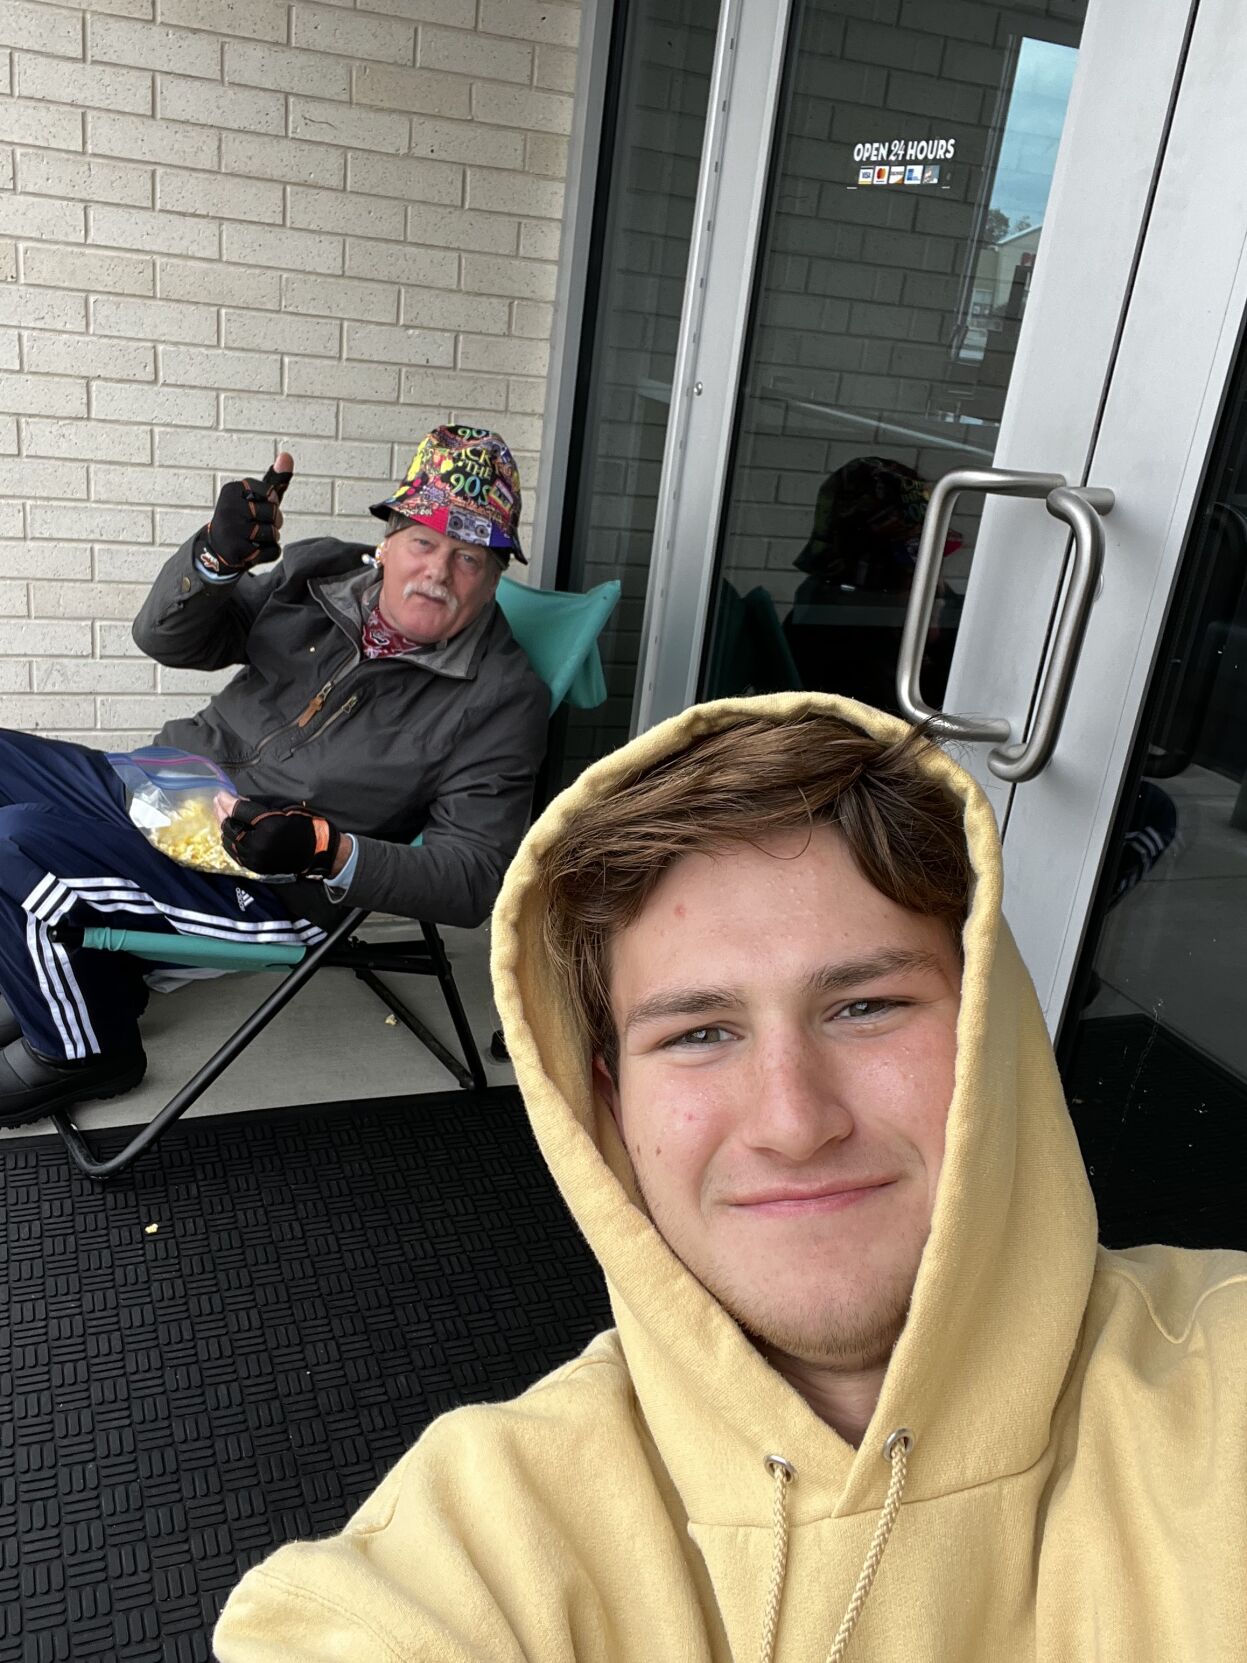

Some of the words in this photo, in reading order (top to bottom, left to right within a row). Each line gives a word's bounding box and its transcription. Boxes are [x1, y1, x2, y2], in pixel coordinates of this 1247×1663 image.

[854, 143, 888, 161] OPEN
[889, 140, 905, 161] 24
[906, 139, 955, 159] HOURS
[465, 460, 491, 478] THE
